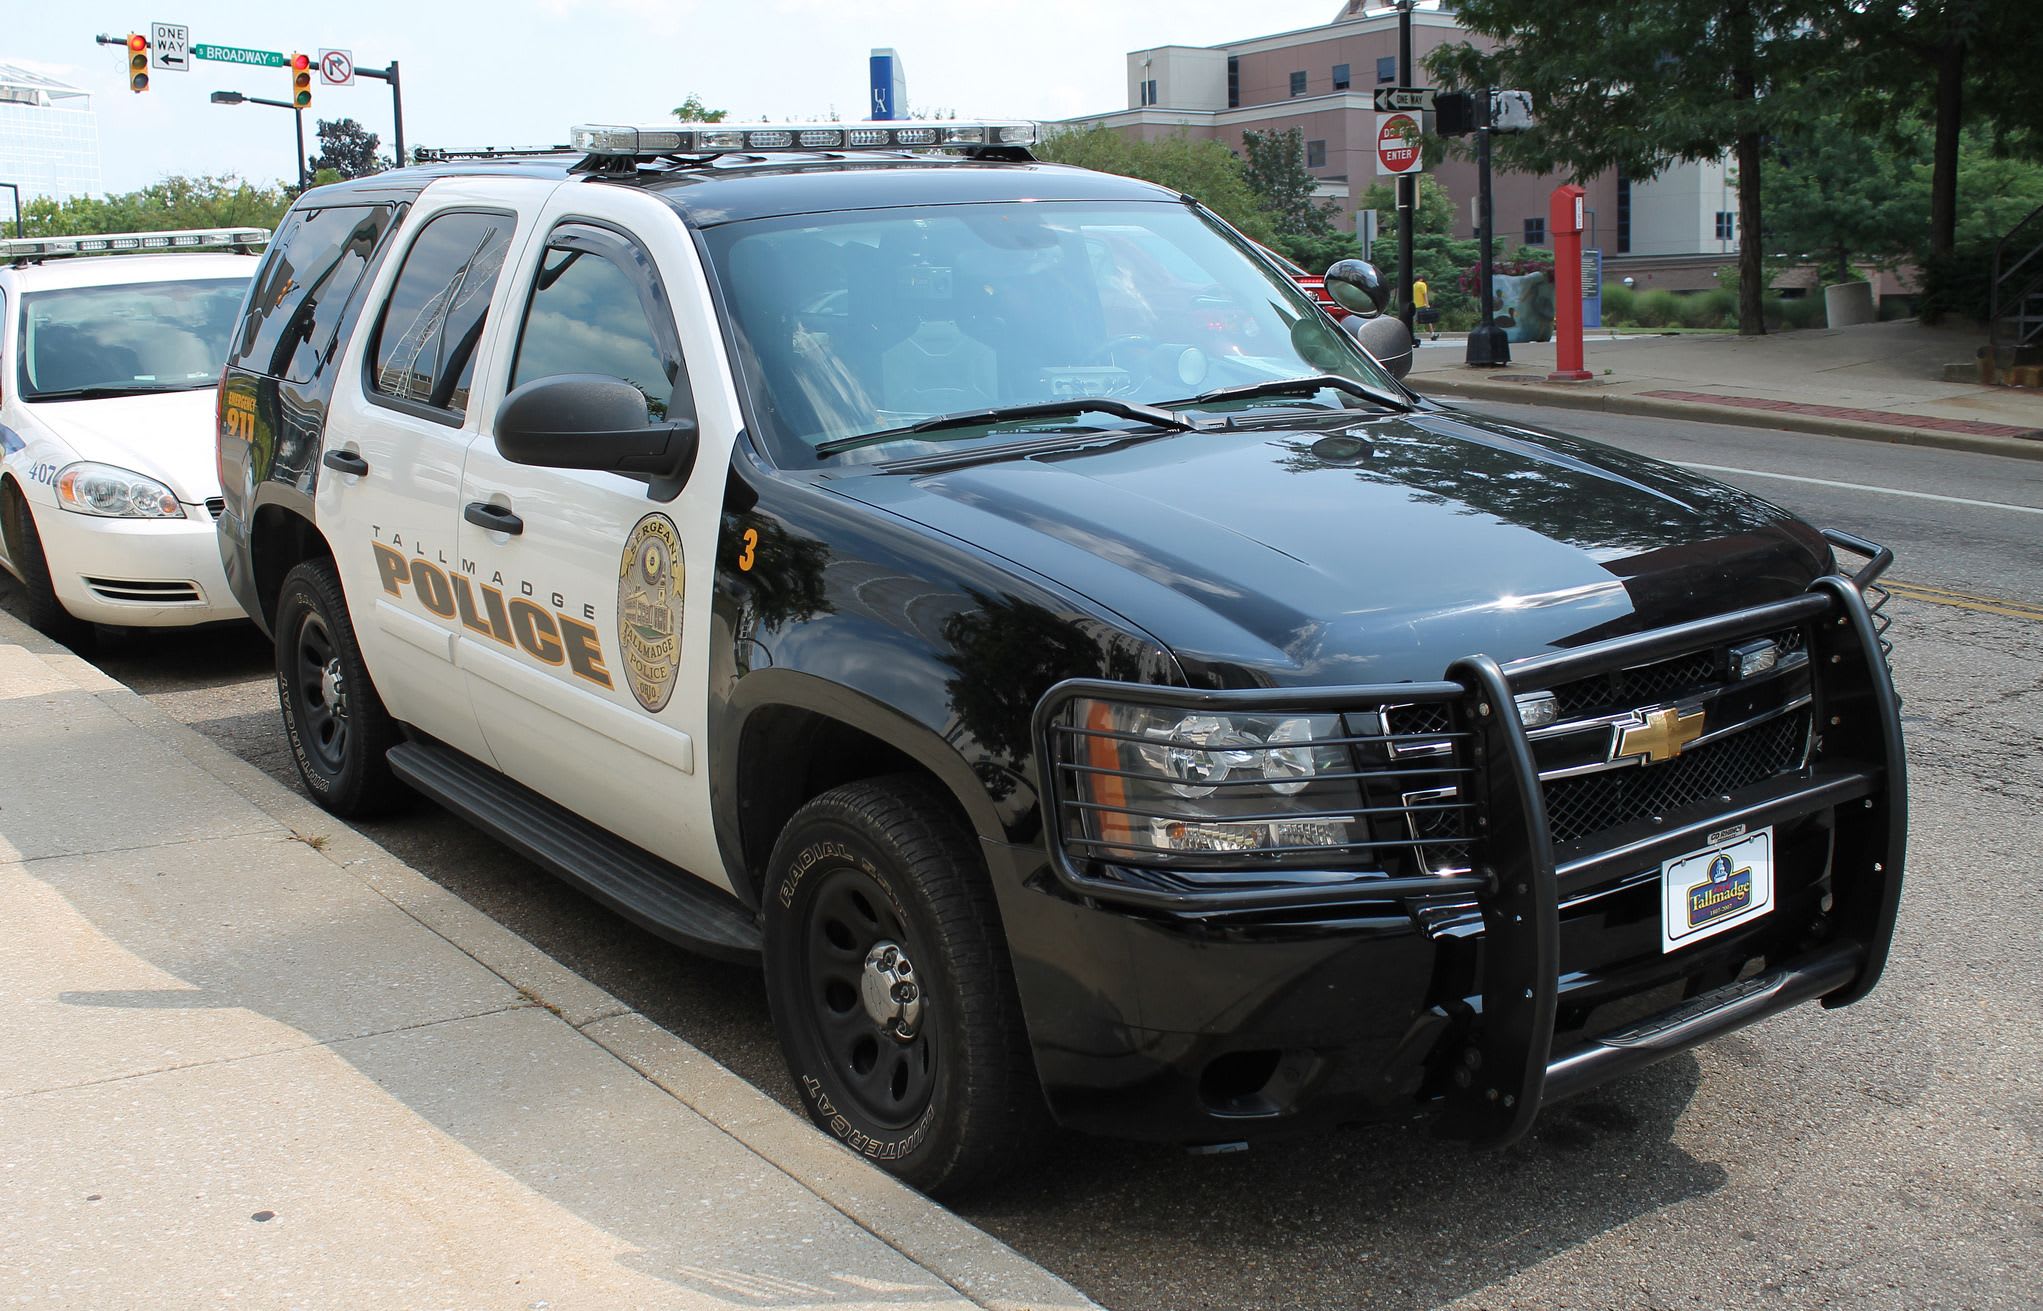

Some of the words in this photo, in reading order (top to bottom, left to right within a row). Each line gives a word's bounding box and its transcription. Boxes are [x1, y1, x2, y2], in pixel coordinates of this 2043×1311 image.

[157, 40, 185, 52] WAY
[158, 27, 184, 40] ONE
[206, 47, 269, 65] BROADWAY
[272, 56, 280, 64] ST
[1397, 95, 1408, 104] ONE
[1410, 95, 1423, 104] WAY
[1387, 150, 1412, 161] ENTER
[227, 408, 254, 443] 911
[29, 460, 57, 486] 407
[631, 522, 679, 568] SERGEANT
[738, 528, 758, 571] 3
[373, 524, 595, 620] TALLMADGE
[371, 540, 615, 691] POLICE
[624, 623, 674, 659] TALLMADGE
[630, 654, 667, 679] POLICE
[780, 842, 853, 908] RADIAL
[1691, 881, 1750, 911] Tallmadge
[803, 1073, 936, 1161] WINTERCAT
